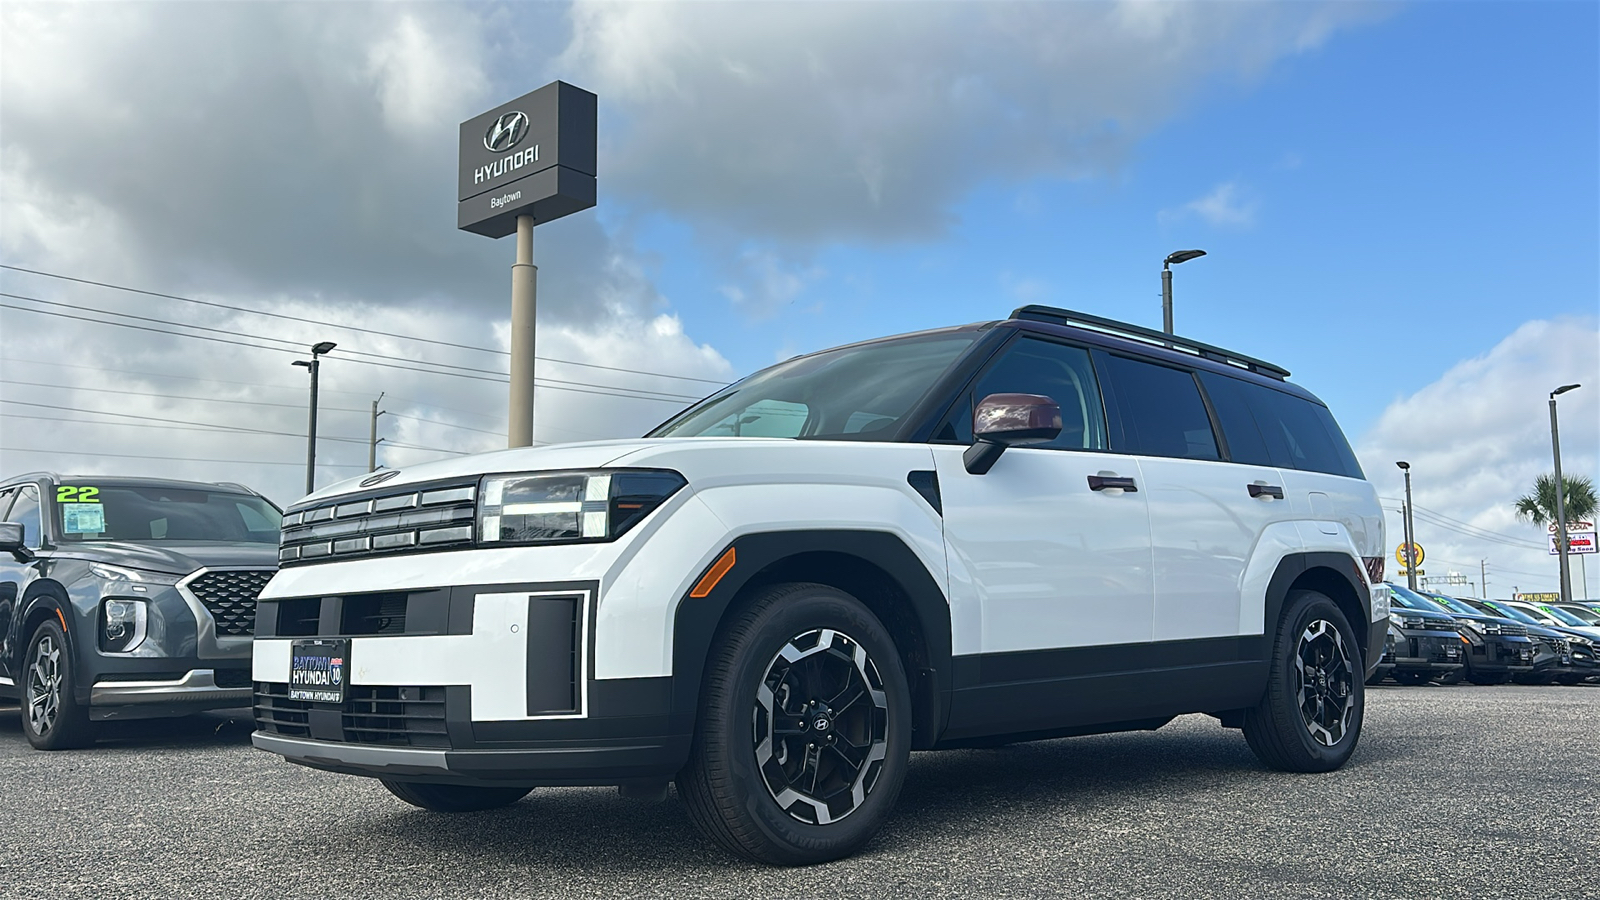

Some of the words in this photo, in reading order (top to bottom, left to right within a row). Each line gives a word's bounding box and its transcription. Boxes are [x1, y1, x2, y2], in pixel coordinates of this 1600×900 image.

[474, 144, 539, 185] HYUNDAI
[490, 190, 521, 209] Baytown
[56, 485, 100, 502] 22
[293, 656, 331, 671] BAYTOWN
[293, 670, 330, 685] HYUNDAI
[332, 667, 340, 681] 10
[291, 690, 314, 700] BAYTOWN
